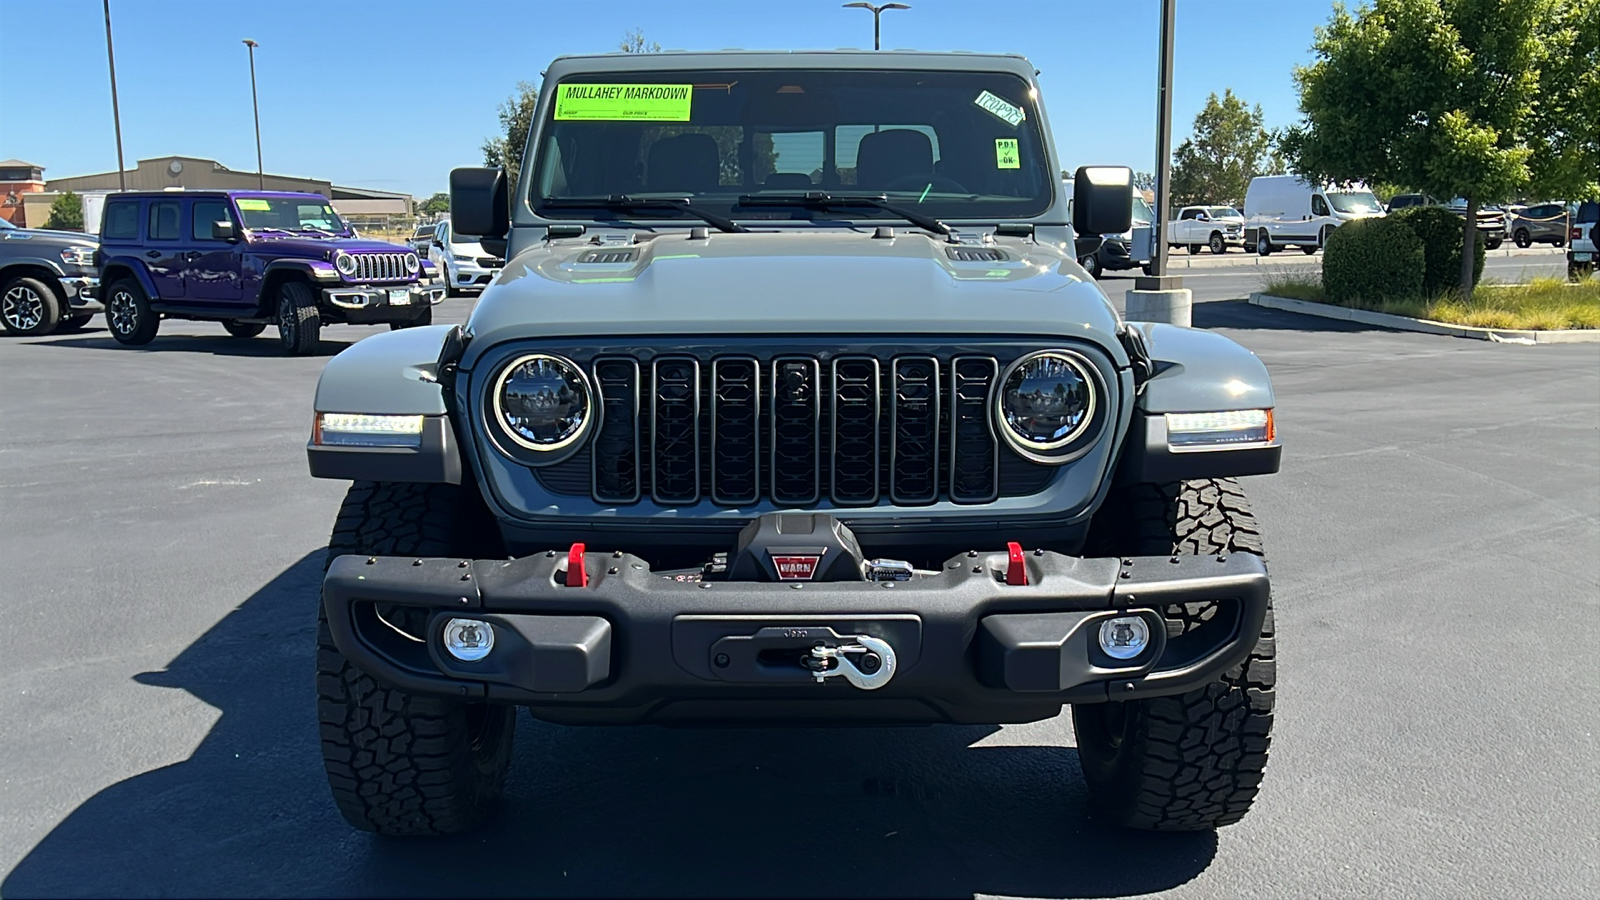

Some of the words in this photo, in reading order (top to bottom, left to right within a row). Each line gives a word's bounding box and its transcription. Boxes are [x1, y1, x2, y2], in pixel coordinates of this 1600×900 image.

[566, 87, 623, 99] MULLAHEY
[624, 87, 688, 100] MARKDOWN
[780, 563, 811, 572] WARN
